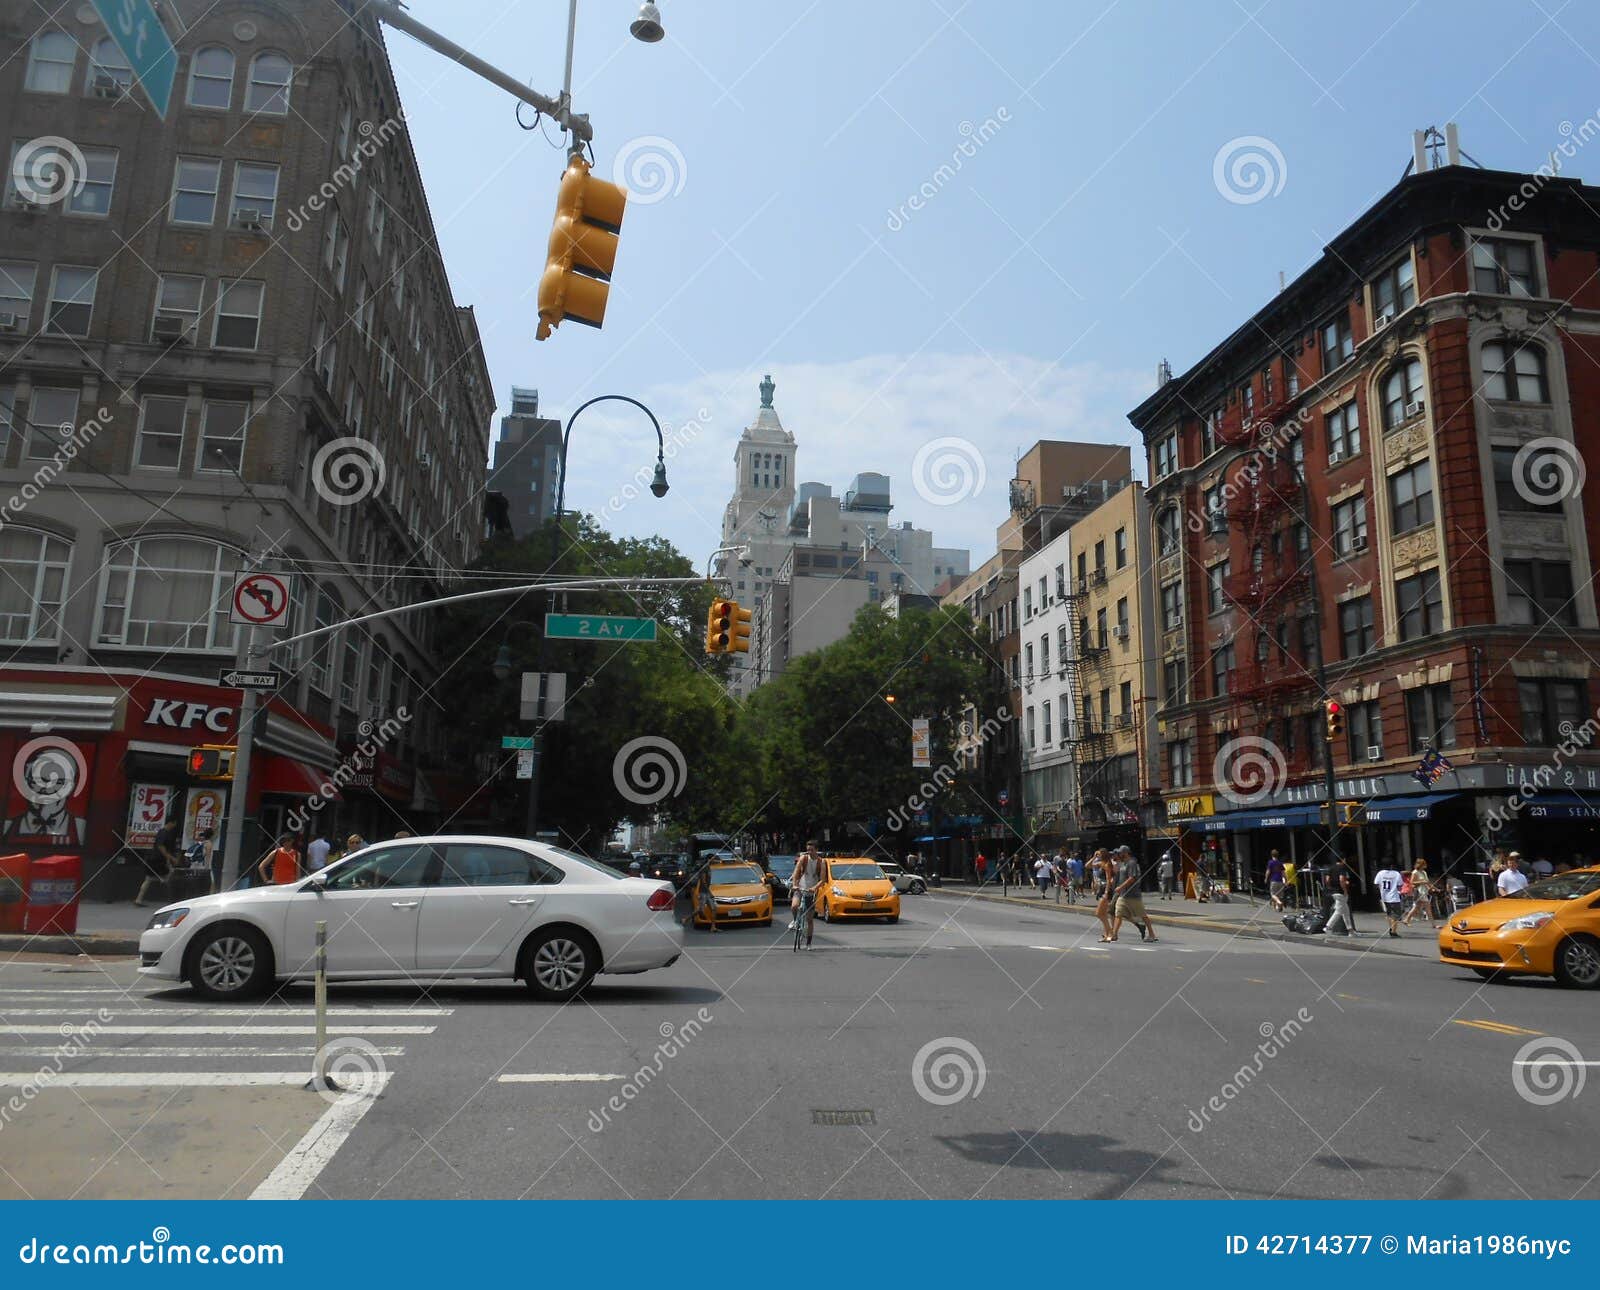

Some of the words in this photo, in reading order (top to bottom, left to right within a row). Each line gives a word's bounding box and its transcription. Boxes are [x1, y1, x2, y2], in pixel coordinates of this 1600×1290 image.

[579, 621, 590, 634] 2
[598, 621, 624, 635] Av
[229, 674, 245, 683] ONE
[253, 675, 272, 684] WAY
[144, 698, 233, 732] KFC
[1564, 770, 1575, 786] &
[1338, 778, 1377, 797] HOOK
[138, 787, 167, 823] $5
[198, 796, 215, 817] 2
[1167, 798, 1199, 816] SUBWAY
[1530, 807, 1547, 816] 231
